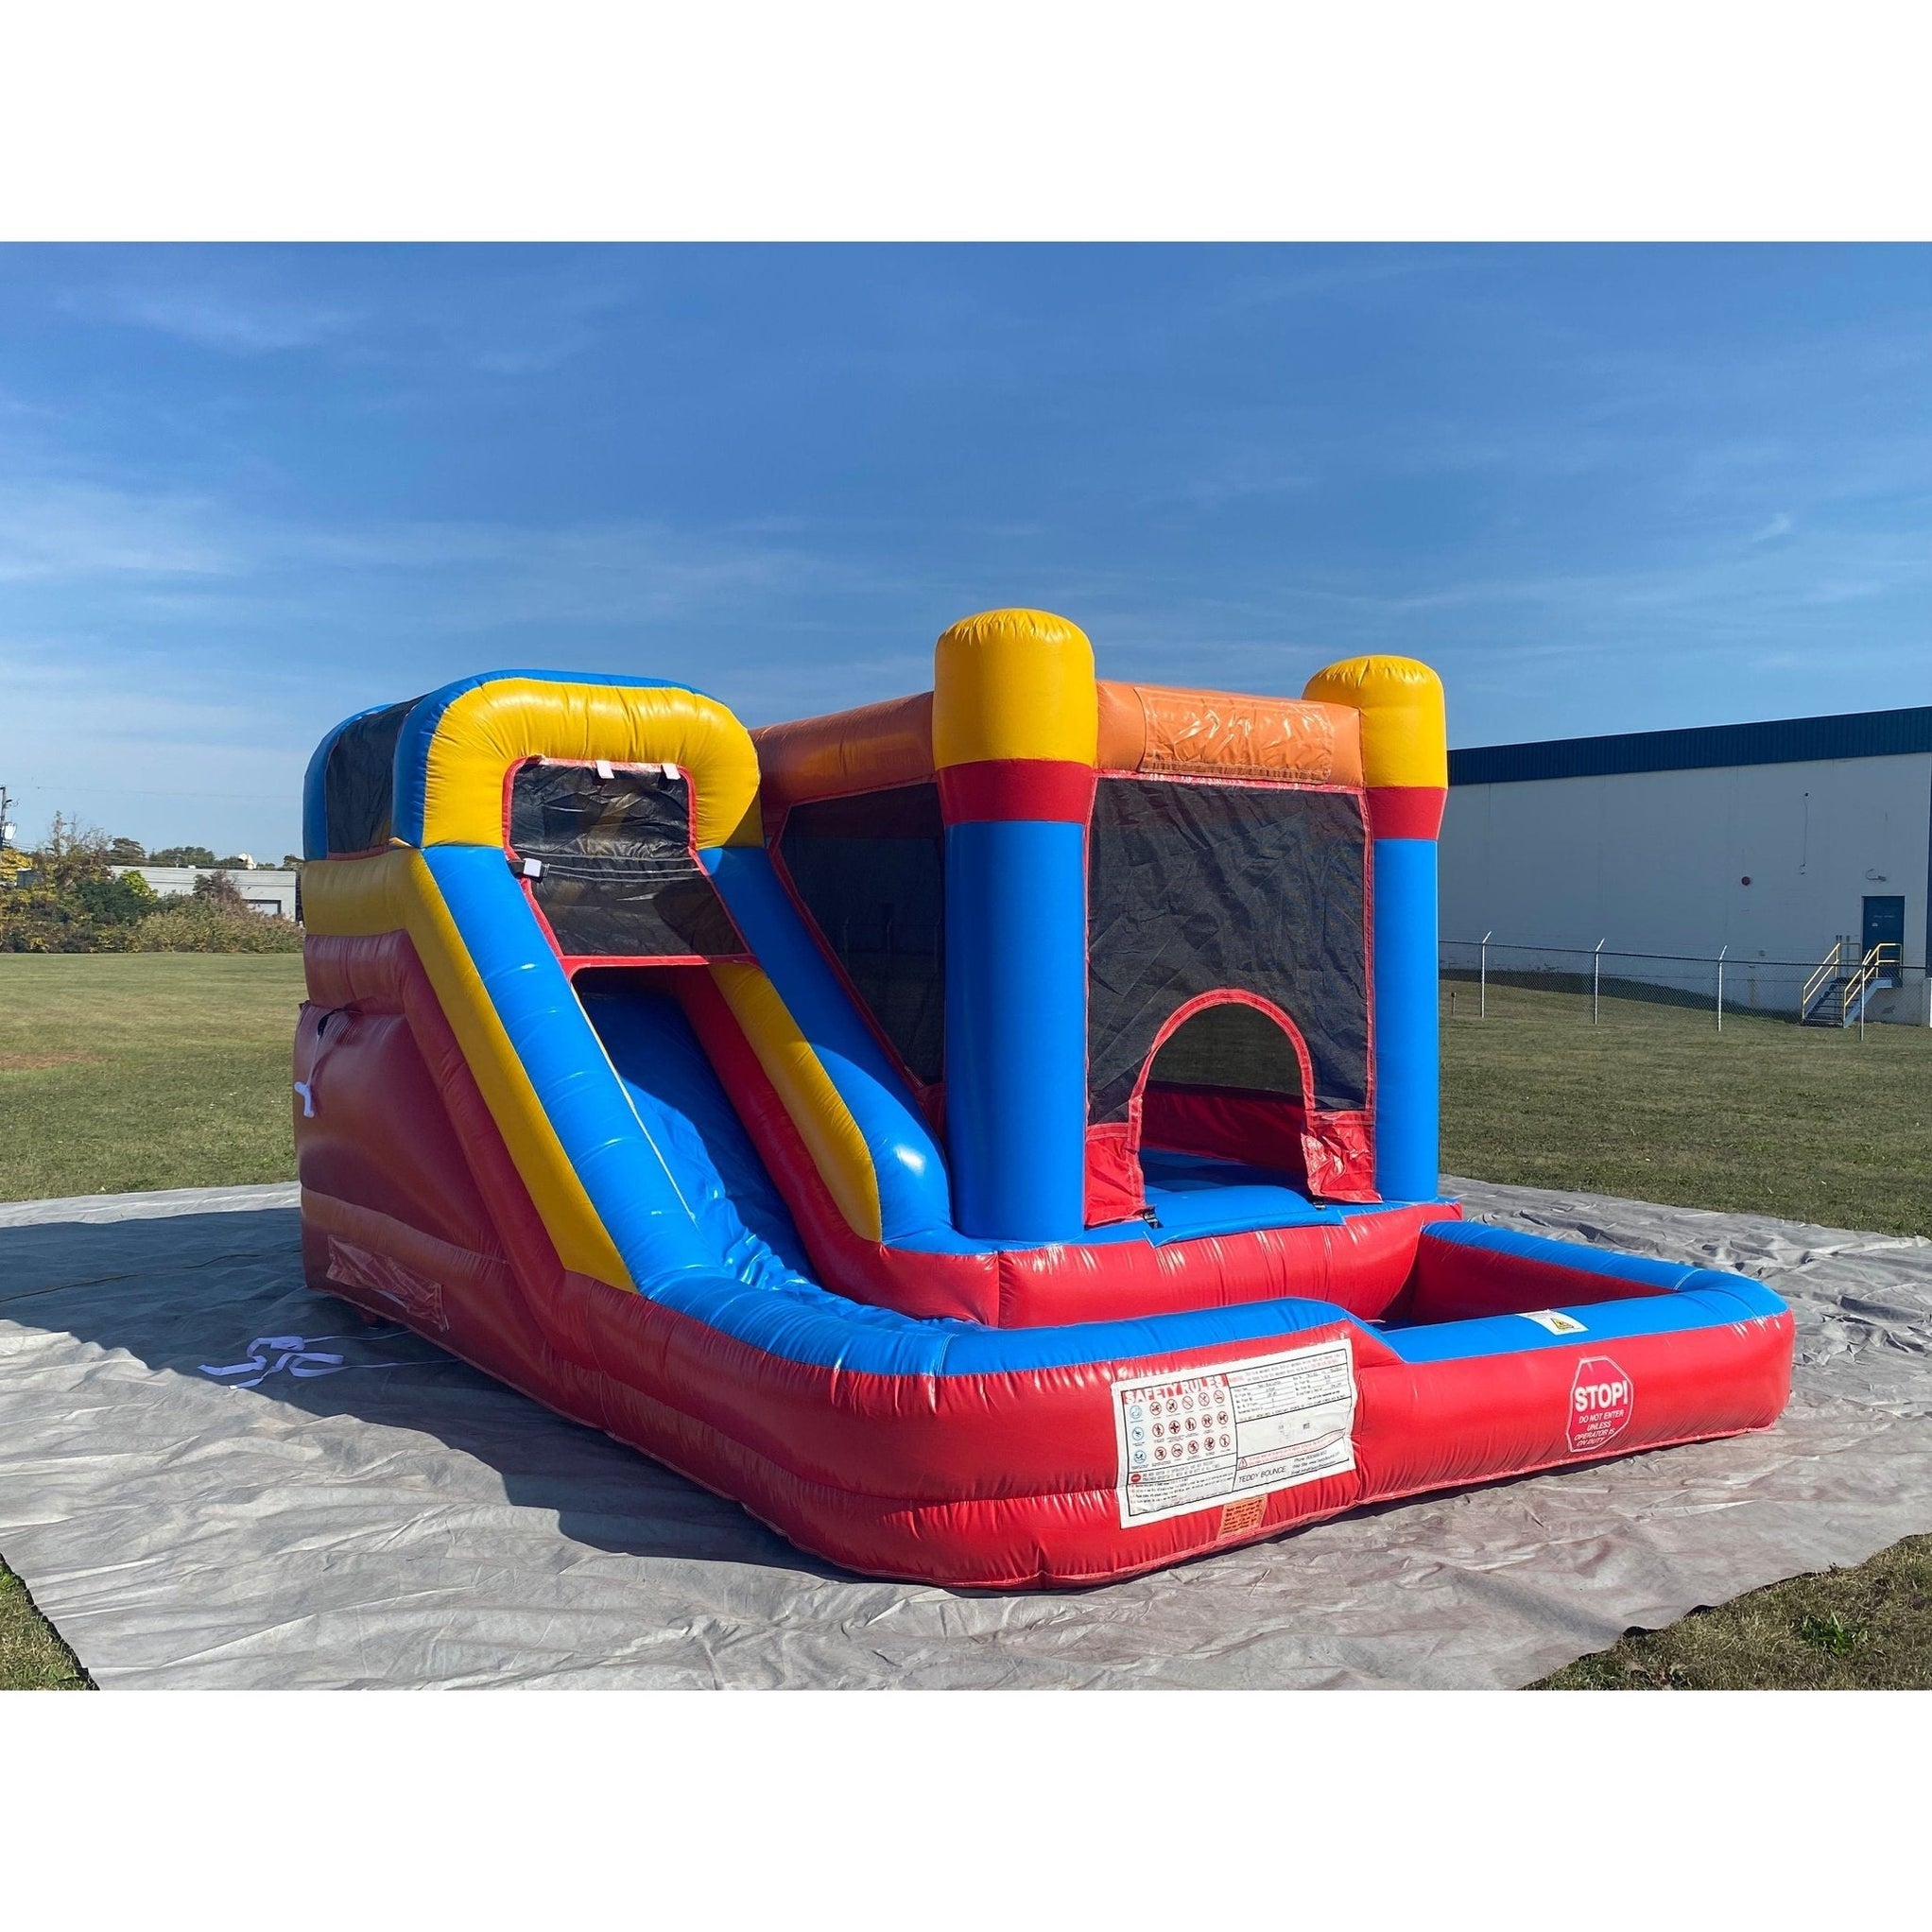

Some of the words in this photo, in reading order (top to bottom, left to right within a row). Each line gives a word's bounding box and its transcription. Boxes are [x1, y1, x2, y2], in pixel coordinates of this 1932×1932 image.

[1124, 1381, 1183, 1404] SAFETY
[1183, 1374, 1224, 1394] RULES
[1575, 1380, 1629, 1412] STOP!
[1578, 1415, 1589, 1423] DO
[1590, 1412, 1604, 1422] NOT
[1603, 1409, 1625, 1420] ENTER
[1587, 1420, 1612, 1431] UNLESS
[1574, 1429, 1608, 1440] OPERATOR
[1608, 1427, 1616, 1436] IS
[1587, 1437, 1605, 1445] DUTY
[1238, 1471, 1259, 1483] TEDDY
[1260, 1466, 1286, 1478] BOUNCE
